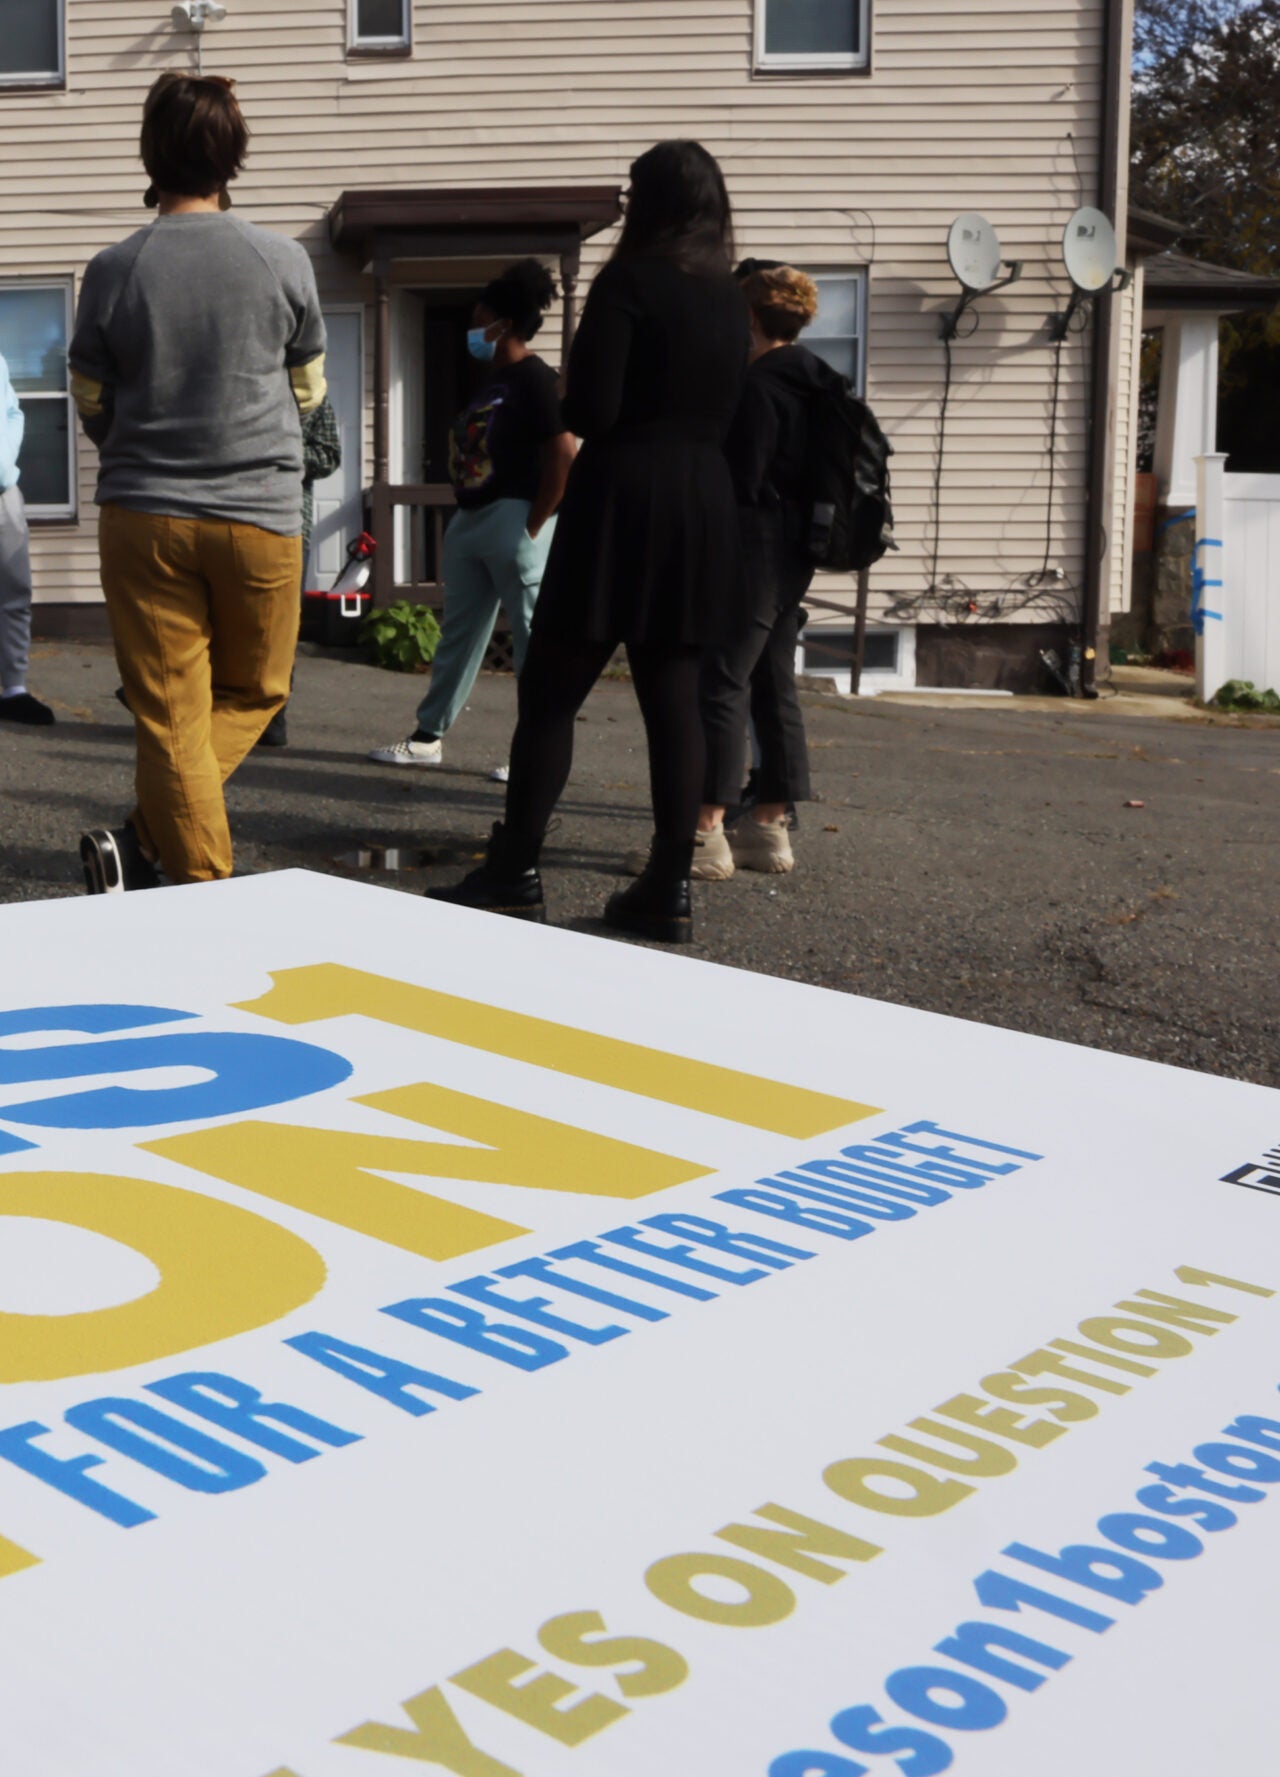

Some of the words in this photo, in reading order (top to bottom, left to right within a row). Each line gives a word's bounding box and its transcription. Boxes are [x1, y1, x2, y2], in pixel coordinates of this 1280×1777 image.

[227, 961, 886, 1140] 1
[711, 1119, 1044, 1242] BUDGET
[379, 1213, 817, 1373] BETTER
[283, 1329, 482, 1418] A
[330, 1610, 690, 1777] YES
[645, 1502, 885, 1629] ON
[823, 1288, 1239, 1519] QUESTION
[1173, 1265, 1276, 1298] 1
